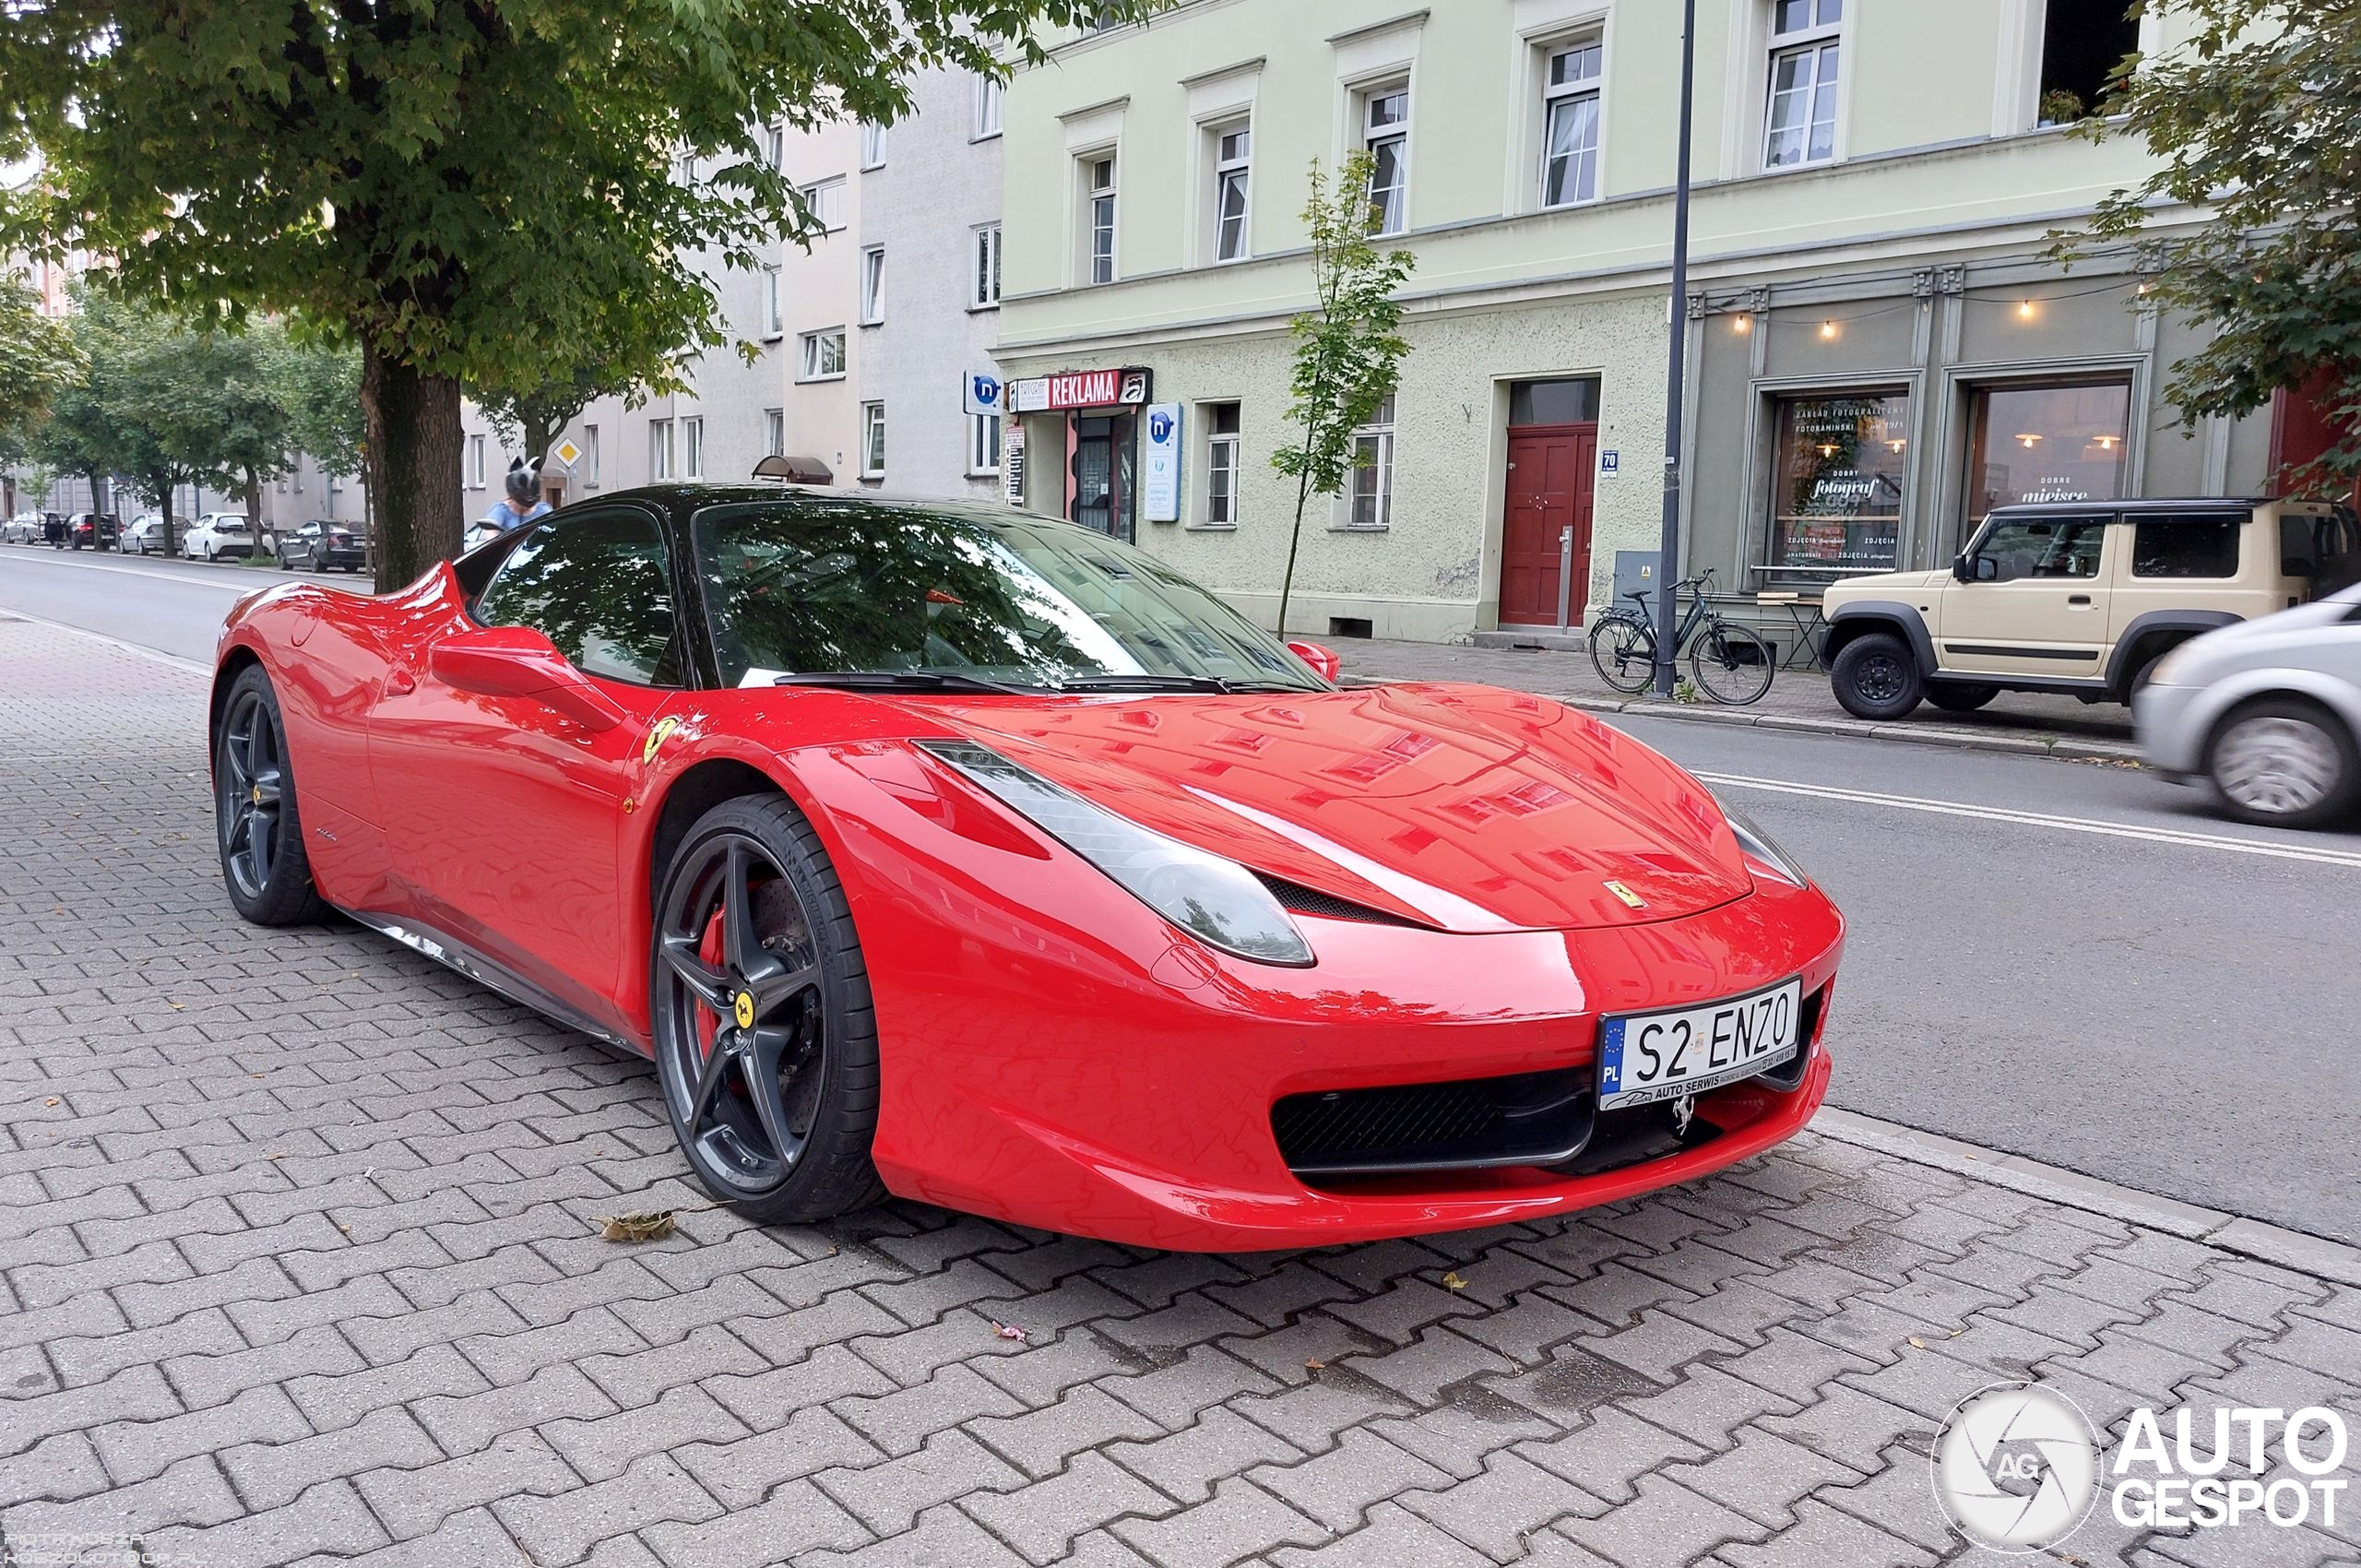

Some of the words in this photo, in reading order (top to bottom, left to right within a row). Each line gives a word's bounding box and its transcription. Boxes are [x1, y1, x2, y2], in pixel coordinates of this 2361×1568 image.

[1052, 372, 1115, 406] REKLAMA
[1604, 455, 1616, 467] 70
[1809, 479, 1880, 499] fotograf
[2040, 476, 2070, 484] DOBRE
[1864, 537, 1895, 545] ZDJĘCIA
[1838, 552, 1868, 560] ZDJĘCIA
[1636, 1018, 1691, 1082] S2
[1708, 992, 1788, 1069] ENZO
[1603, 1065, 1619, 1084] PL
[1655, 1084, 1682, 1099] AUTO
[1685, 1075, 1719, 1093] SERWIS
